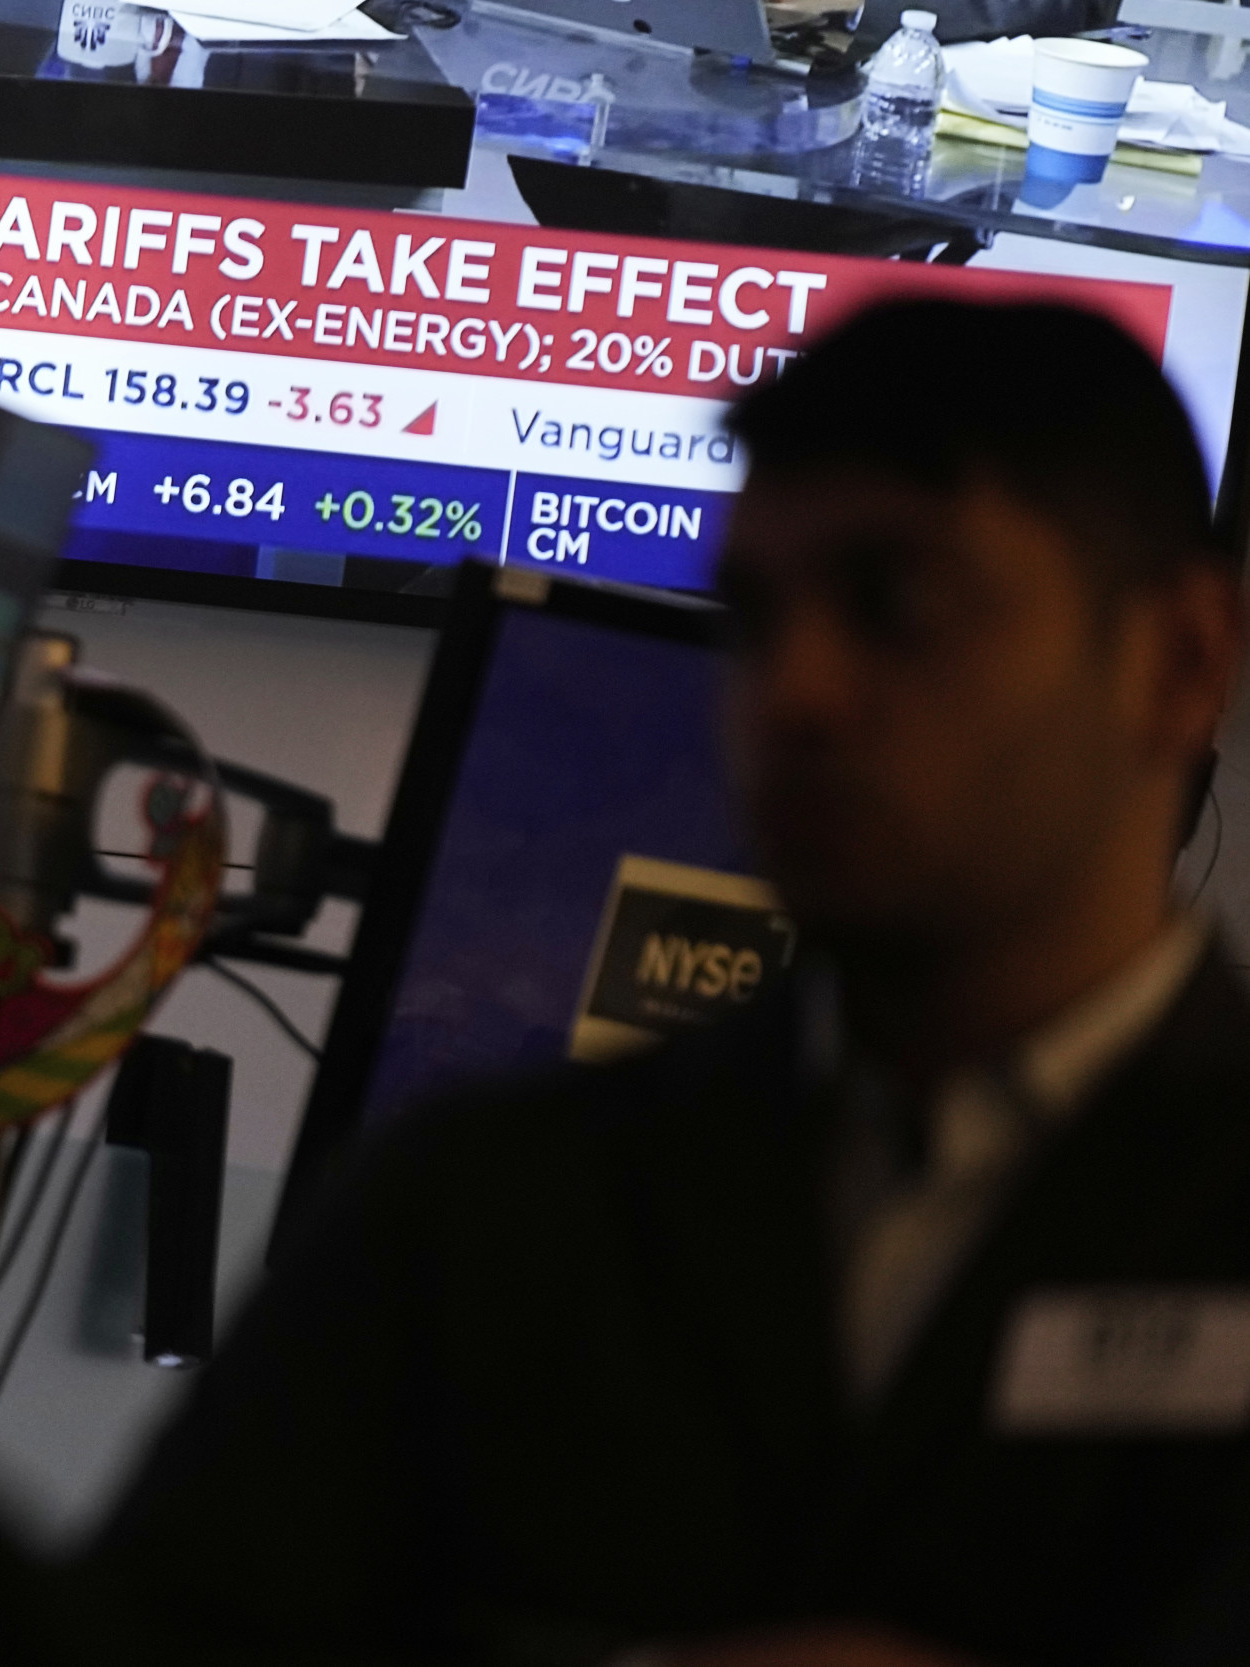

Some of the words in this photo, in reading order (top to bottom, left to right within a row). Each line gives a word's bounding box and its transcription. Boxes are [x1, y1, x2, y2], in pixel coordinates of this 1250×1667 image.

[291, 223, 497, 304] TAKE
[516, 246, 827, 334] EFFECT
[210, 291, 554, 374] (EX-ENERGY);
[566, 329, 673, 378] 20%
[687, 340, 807, 386] DUT
[105, 367, 250, 416] 158.39
[268, 386, 383, 429] -3.63
[512, 407, 735, 464] Vanguard
[154, 474, 286, 521] +6.84
[315, 490, 482, 542] +0.32%
[531, 491, 702, 540] BITCOIN
[527, 528, 590, 565] CM
